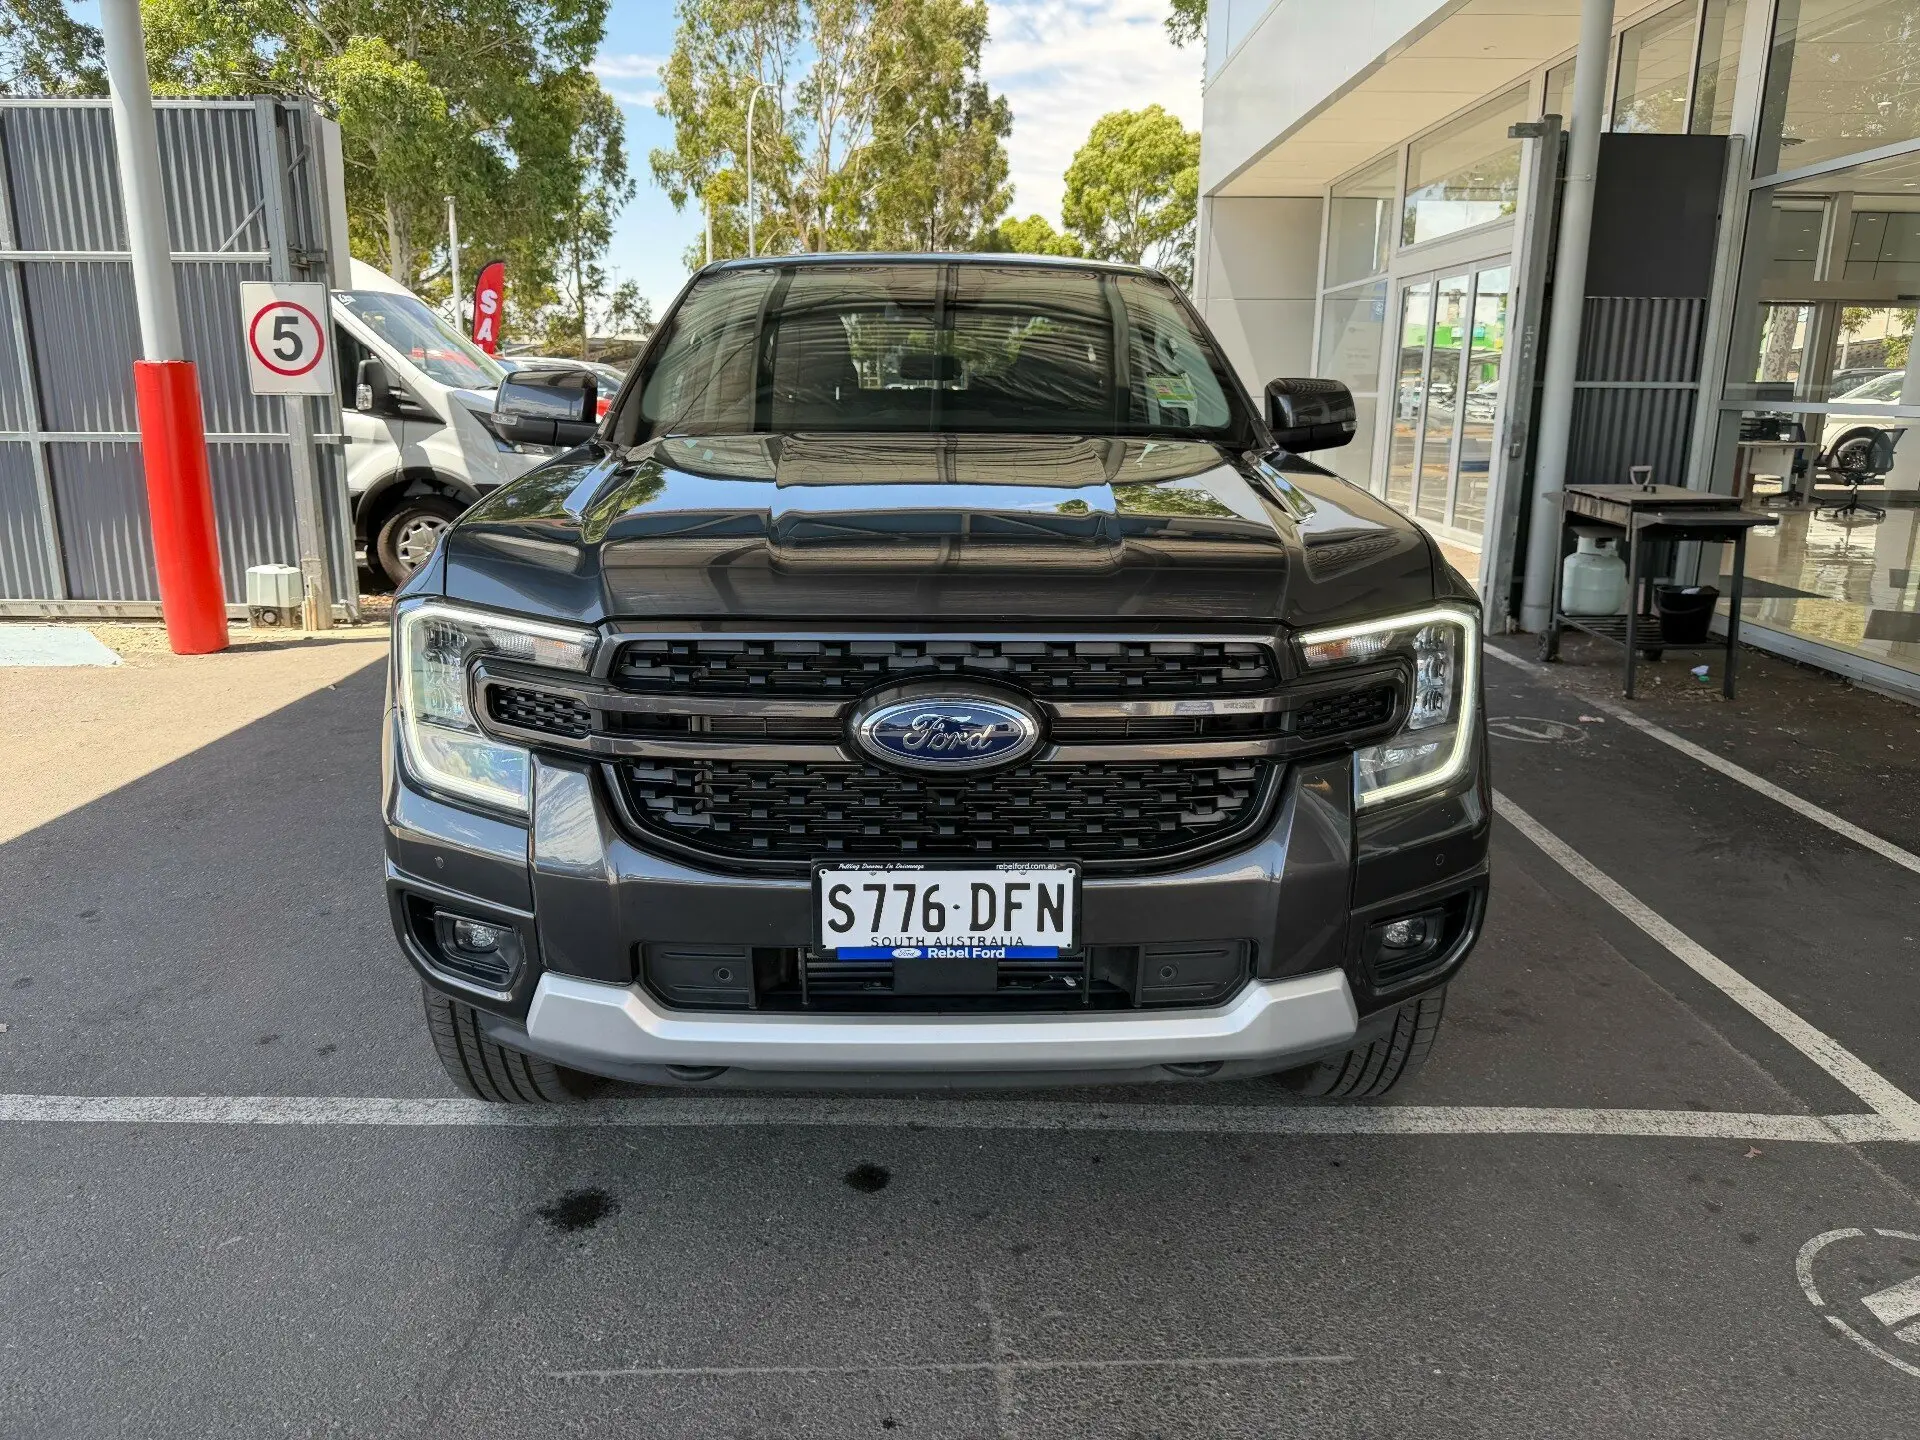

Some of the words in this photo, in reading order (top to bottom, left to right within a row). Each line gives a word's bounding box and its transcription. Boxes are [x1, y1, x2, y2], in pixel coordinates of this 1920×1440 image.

[477, 289, 498, 350] SA
[273, 316, 303, 361] 5
[902, 714, 994, 750] Ford
[871, 936, 925, 946] SOUTH
[934, 936, 1024, 946] AUSTRALIA
[927, 947, 969, 958] Rebel
[972, 947, 1006, 958] Ford
